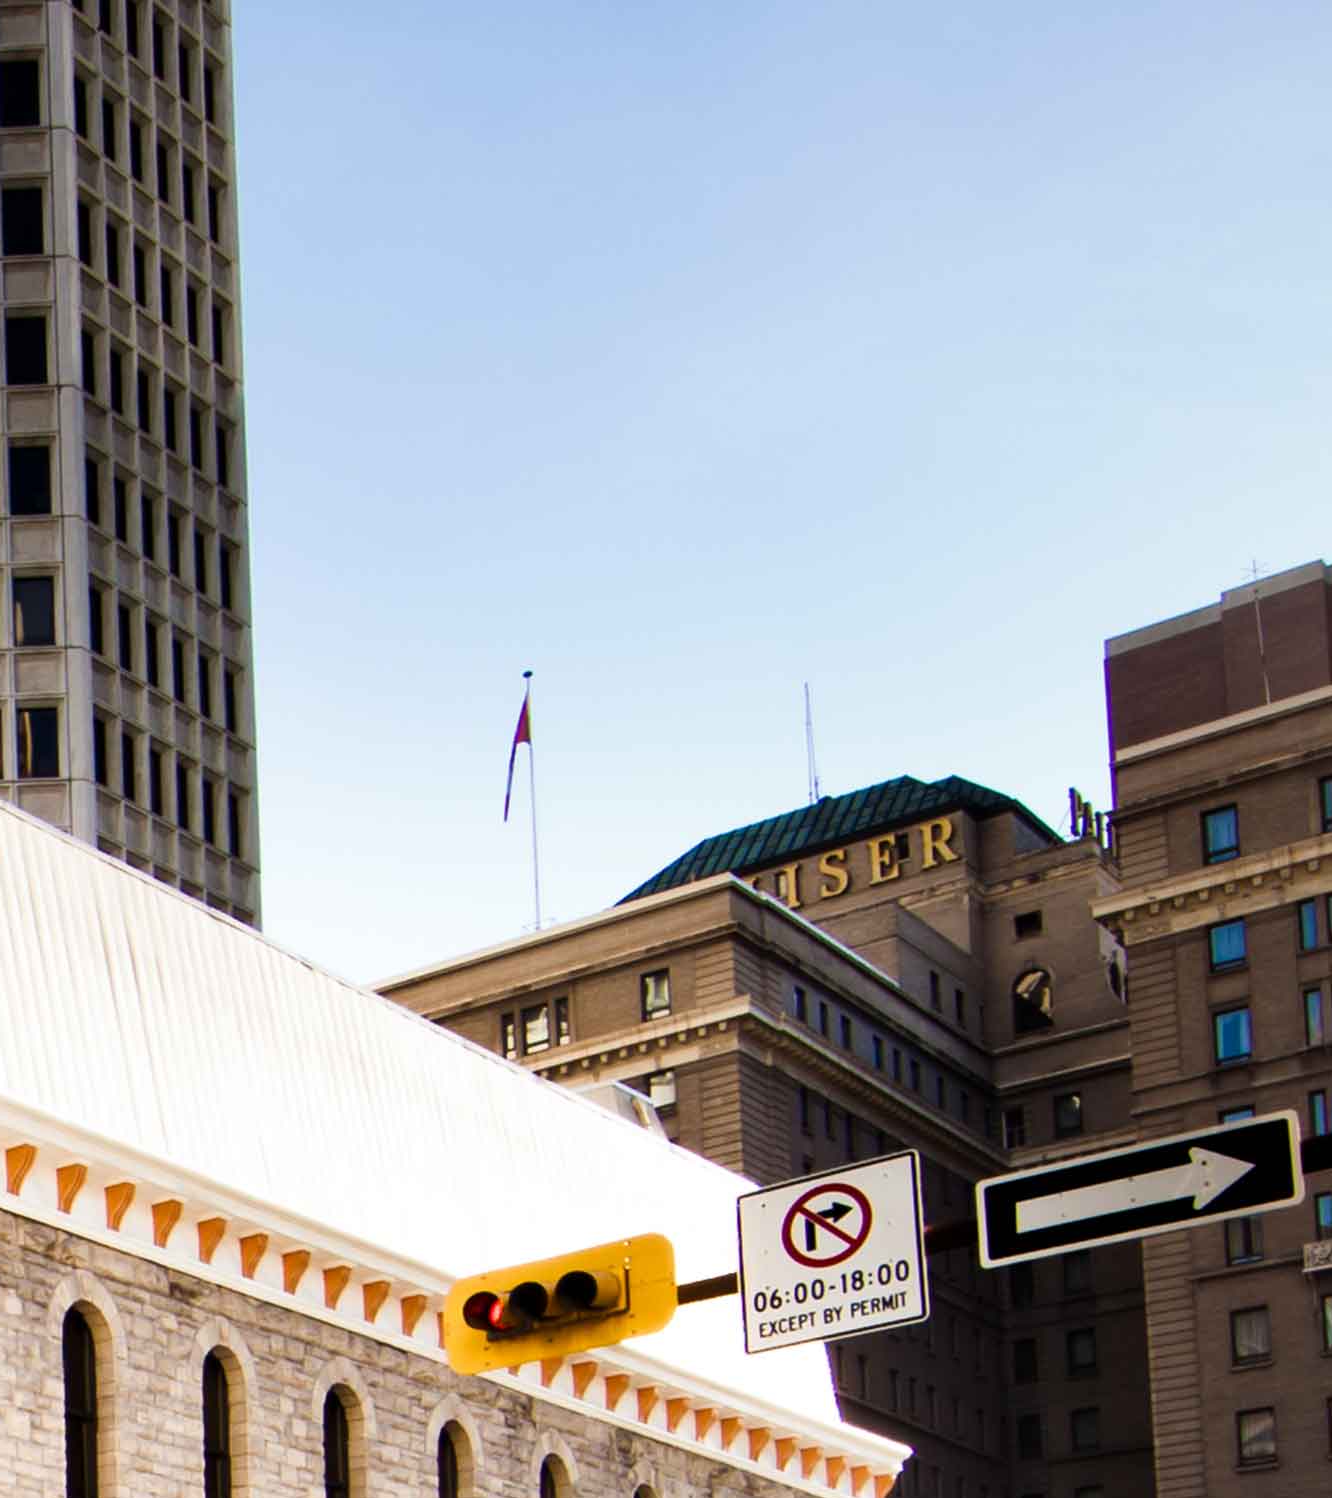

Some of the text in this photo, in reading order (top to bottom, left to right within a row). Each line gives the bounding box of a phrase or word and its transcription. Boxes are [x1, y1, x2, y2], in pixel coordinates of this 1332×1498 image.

[743, 816, 959, 909] ISER
[753, 1259, 910, 1313] 06:00-18:00
[758, 1291, 908, 1339] EXCEPT BY PERMIT
